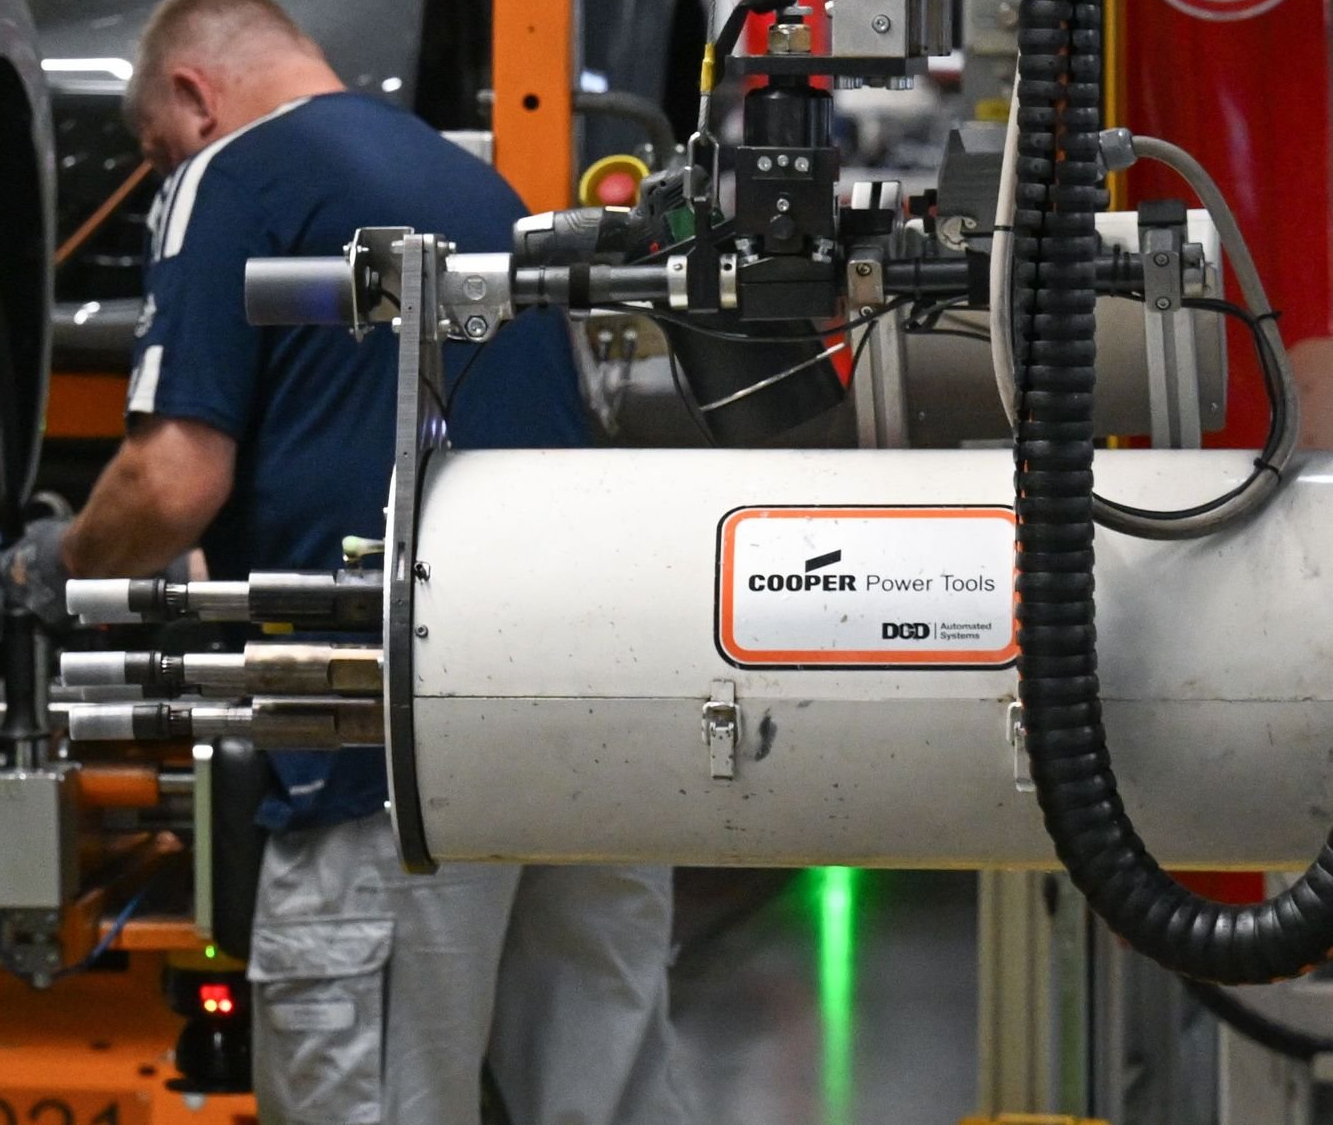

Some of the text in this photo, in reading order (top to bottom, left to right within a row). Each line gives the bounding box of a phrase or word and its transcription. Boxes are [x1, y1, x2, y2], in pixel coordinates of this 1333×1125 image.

[748, 573, 995, 592] COOPER Power Tools
[940, 622, 992, 631] Automated
[940, 631, 981, 641] Systems
